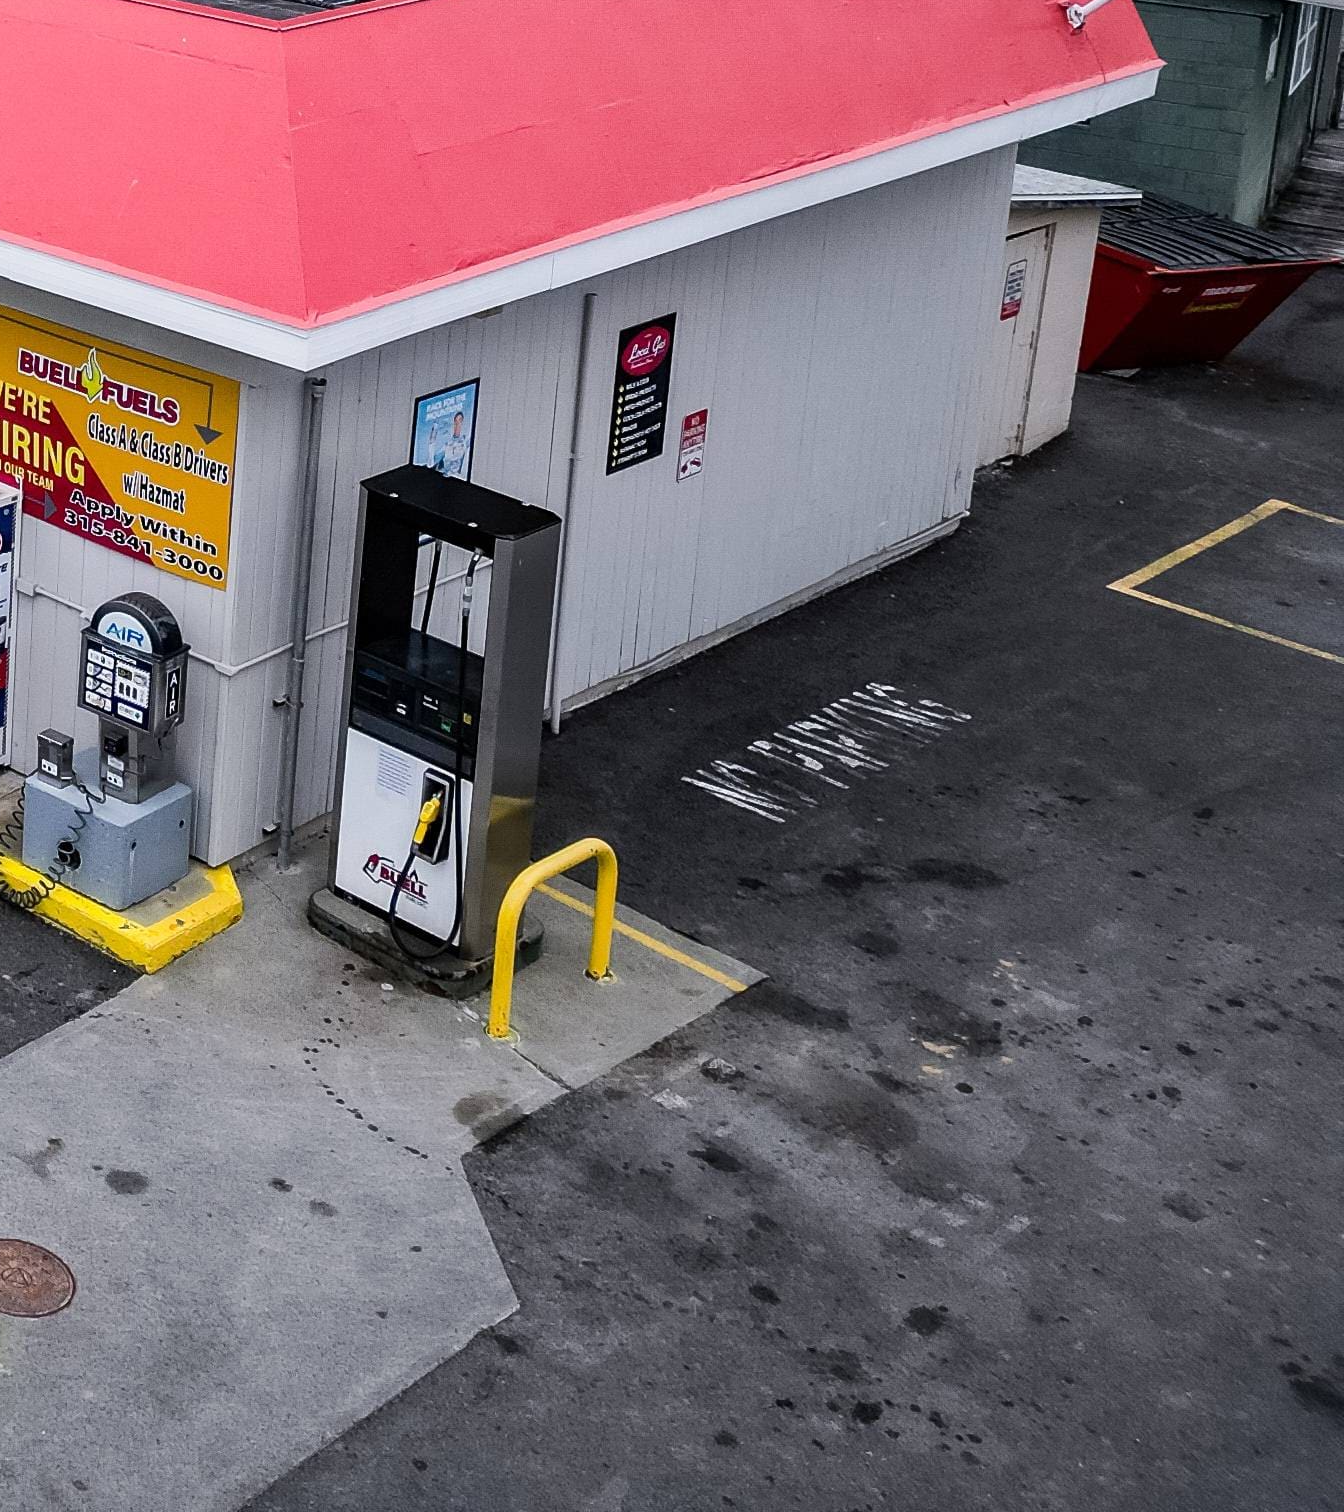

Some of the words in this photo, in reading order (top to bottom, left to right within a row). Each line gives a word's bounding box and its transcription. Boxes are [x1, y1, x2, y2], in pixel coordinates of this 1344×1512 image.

[627, 340, 651, 363] Local
[101, 376, 180, 426] FUELS
[87, 413, 117, 446] Class
[117, 424, 127, 450] A
[129, 428, 138, 453] &
[140, 431, 171, 464] Class
[173, 443, 183, 467] B
[184, 446, 229, 485] Drivers
[26, 468, 54, 492] TEAM
[138, 473, 186, 514] Hazmat
[63, 507, 225, 582] 315-841-3000
[71, 489, 135, 527] Apply
[139, 512, 218, 558] Within
[105, 622, 145, 648] AIR
[168, 672, 179, 716] AIR
